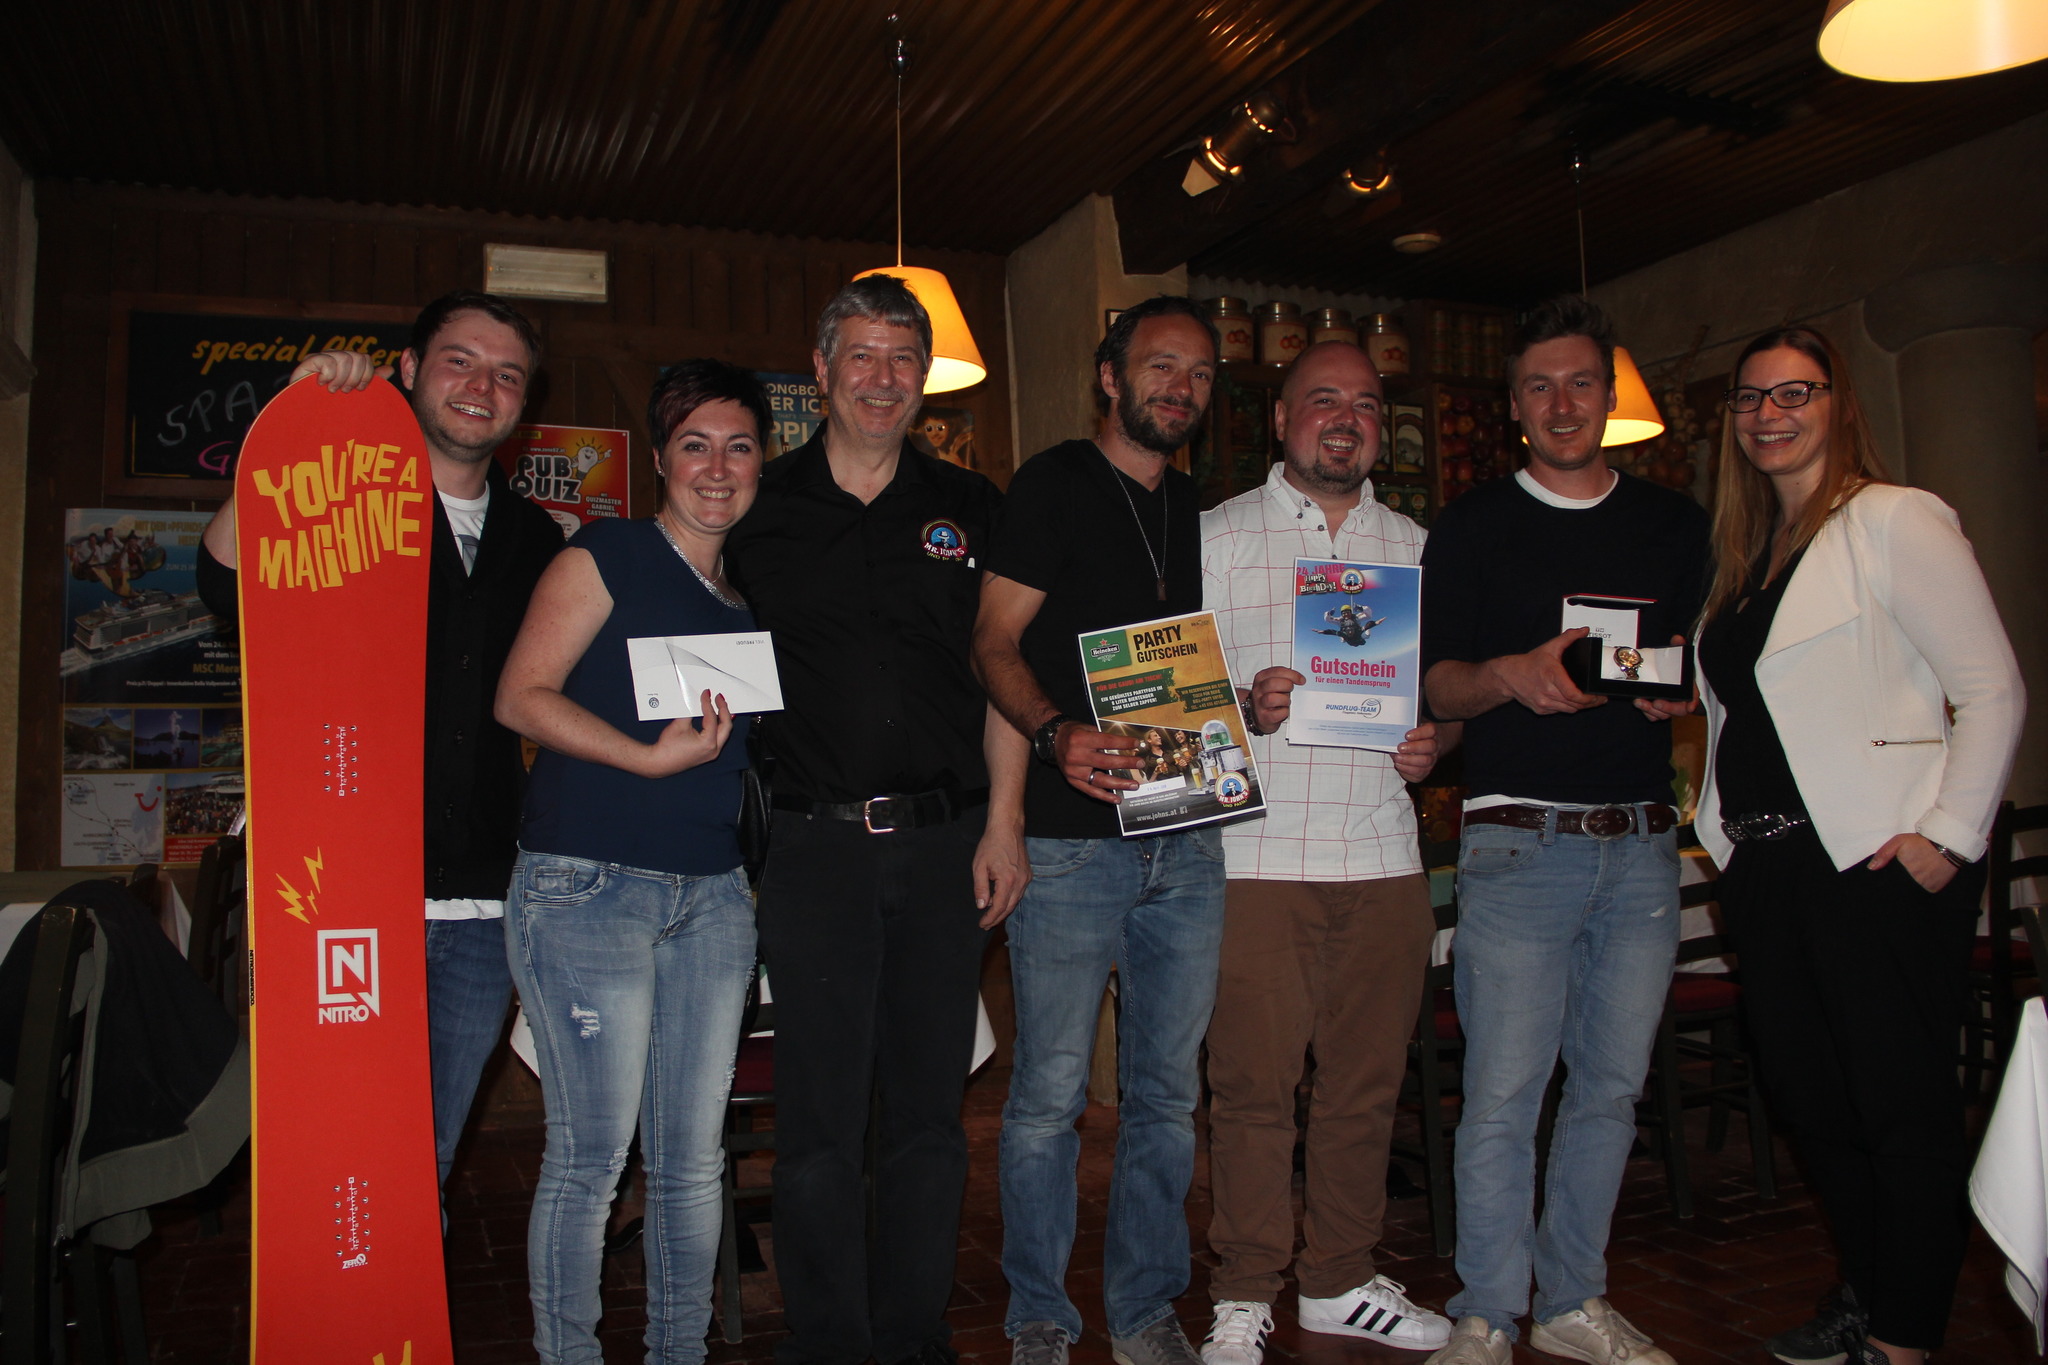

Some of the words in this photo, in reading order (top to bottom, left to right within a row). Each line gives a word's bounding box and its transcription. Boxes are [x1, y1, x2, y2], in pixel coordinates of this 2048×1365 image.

[192, 335, 316, 375] special
[766, 382, 818, 396] ONGBO
[156, 373, 291, 447] SPA
[769, 396, 795, 412] ER
[516, 454, 573, 479] PUB
[252, 438, 402, 529] YOU'RE
[397, 456, 418, 489] A
[509, 475, 581, 504] QUIZ
[585, 495, 622, 506] QUIZMASTER
[258, 488, 425, 592] MACHINE
[1311, 563, 1346, 575] JAHRE
[1132, 624, 1183, 651] PARTY
[1137, 642, 1199, 664] GUTSCHEIN
[192, 663, 214, 673] MSC
[215, 663, 241, 673] Mera
[1310, 655, 1396, 678] Gutschein
[1315, 675, 1325, 683] für
[1326, 676, 1344, 684] einen
[1345, 677, 1391, 688] Tandemsprung
[1325, 703, 1377, 713] RUNDFLUG-TEAM
[1135, 807, 1178, 823] www.johns.at
[317, 1003, 370, 1025] NITRO
